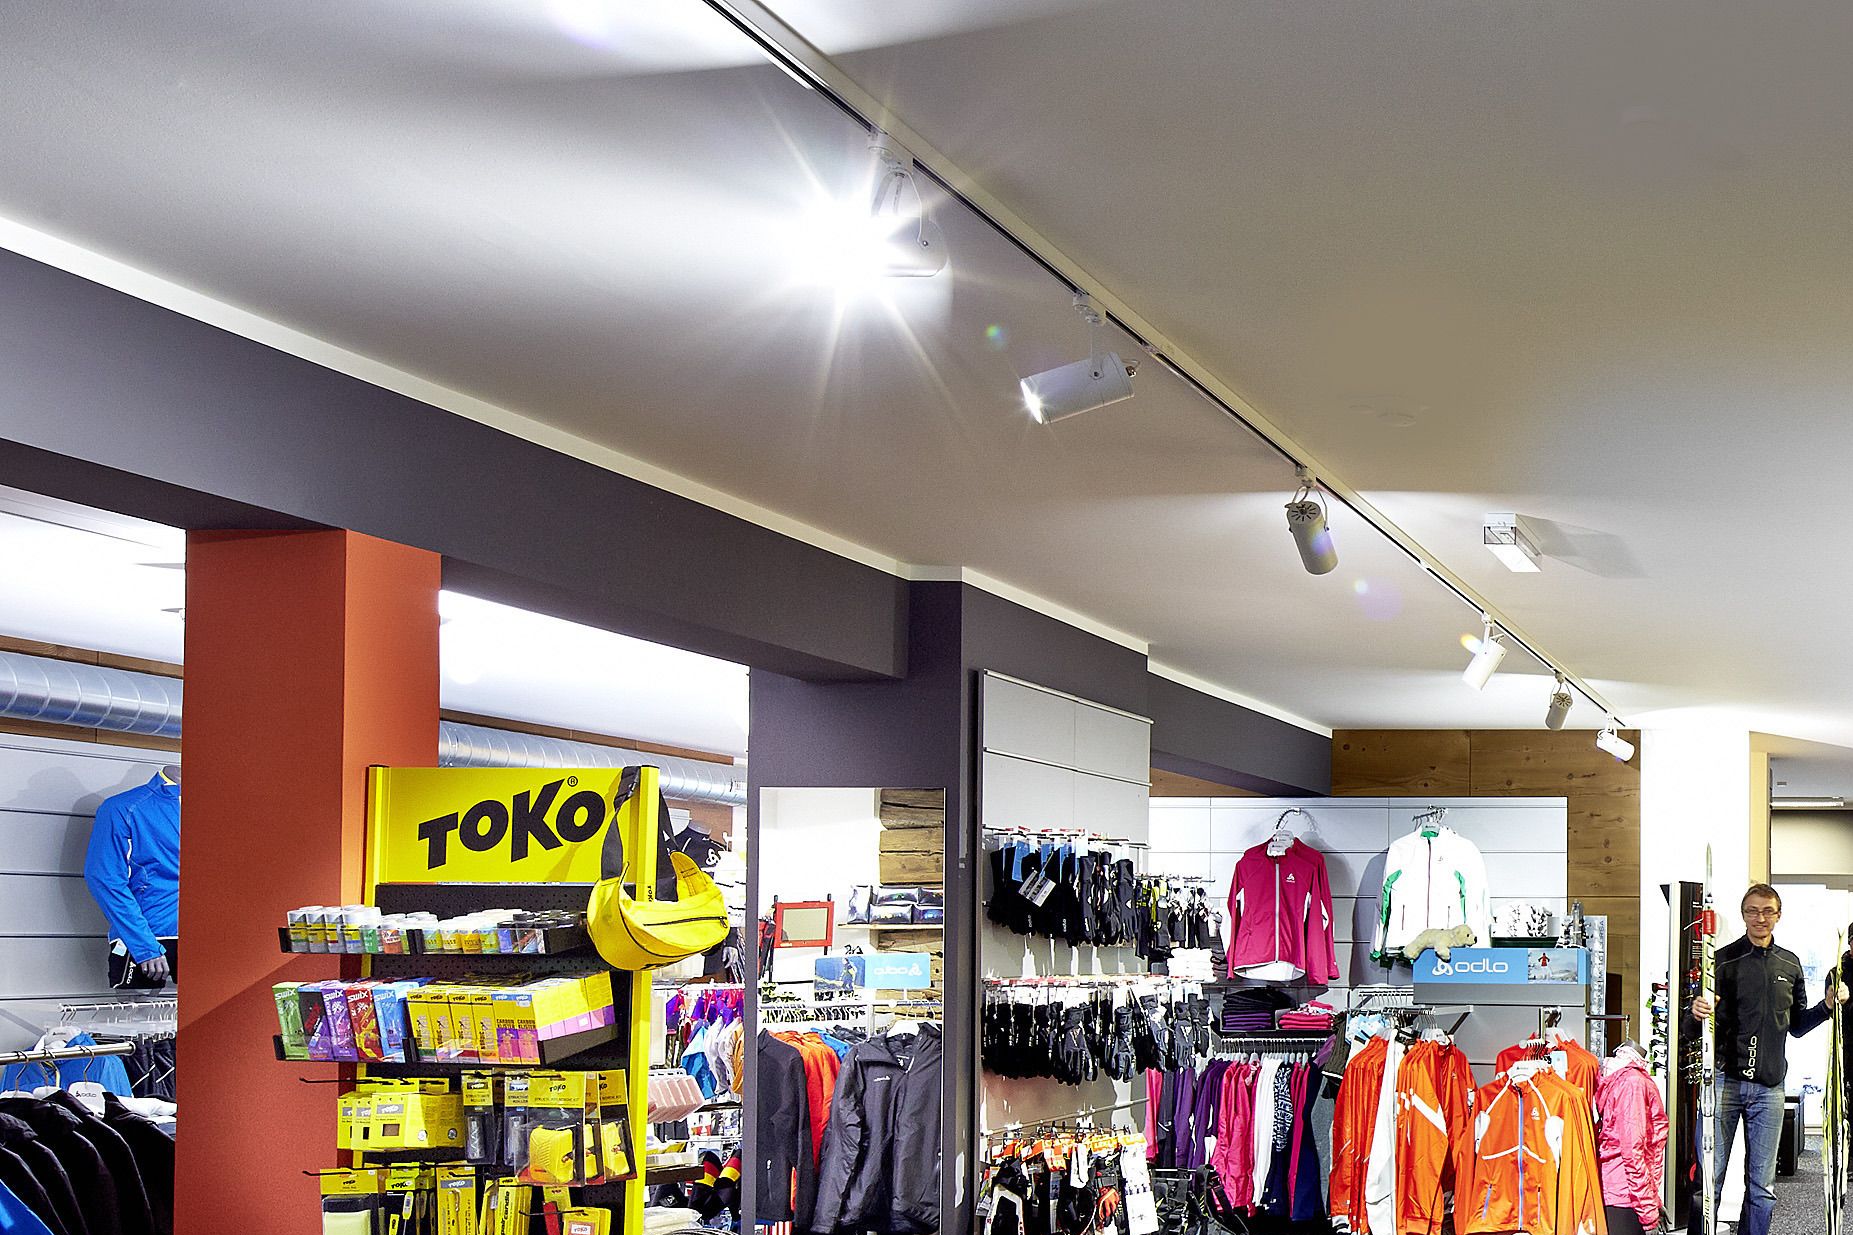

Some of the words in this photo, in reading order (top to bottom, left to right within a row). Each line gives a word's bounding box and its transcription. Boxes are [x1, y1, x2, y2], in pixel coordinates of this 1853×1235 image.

[418, 778, 606, 871] TOKO
[1454, 957, 1509, 973] odlo
[275, 988, 296, 1001] swix
[323, 989, 344, 1001] swix
[347, 990, 369, 1003] swix
[1748, 1035, 1758, 1068] odlo
